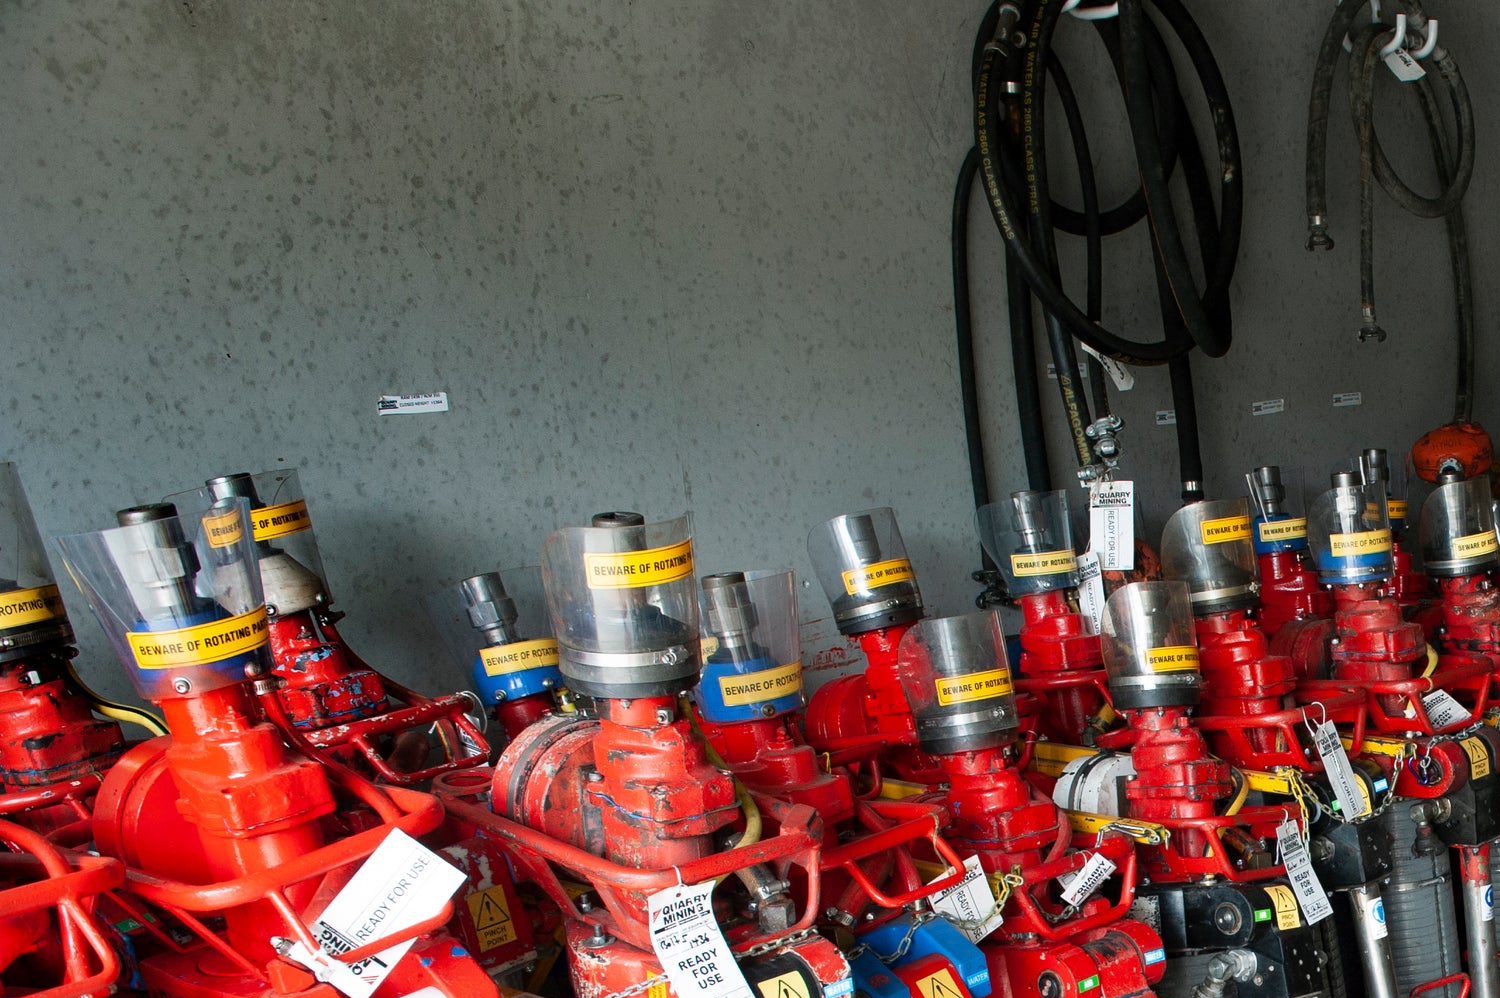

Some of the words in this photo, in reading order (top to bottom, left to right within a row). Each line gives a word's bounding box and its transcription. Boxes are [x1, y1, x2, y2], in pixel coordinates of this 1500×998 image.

[1032, 22, 1040, 39] AIR
[1024, 51, 1035, 87] WATER
[978, 74, 989, 108] WATER
[1024, 91, 1031, 105] AS
[978, 111, 986, 127] AS
[1024, 134, 1034, 172] CLASS
[982, 157, 998, 197] CLASS
[994, 199, 1001, 208] B
[1027, 185, 1039, 215] FRAS
[998, 210, 1015, 241] FRAS
[1063, 387, 1092, 466] ALFAGOMMA
[259, 517, 270, 529] OF
[1206, 525, 1232, 535] BEWARE
[1232, 524, 1239, 533] OF
[1333, 539, 1358, 549] BEWARE
[1360, 538, 1368, 547] OF
[1458, 541, 1480, 552] BEWARE
[594, 565, 636, 576] BEWARE
[639, 563, 652, 574] OF
[654, 556, 687, 571] ROTATING
[1016, 559, 1040, 569] BEWARE
[1041, 559, 1048, 567] OF
[876, 570, 883, 578] OF
[1087, 582, 1095, 605] READY
[139, 642, 184, 656] BEWARE
[187, 639, 201, 652] OF
[205, 627, 251, 648] ROTATING
[486, 653, 519, 667] BEWARE
[520, 650, 531, 661] OF
[1149, 655, 1176, 664] BEWARE
[1177, 654, 1183, 662] OF
[725, 682, 761, 697] BEWARE
[762, 680, 774, 692] OF
[942, 683, 973, 695] BEWARE
[974, 681, 983, 691] OF
[1281, 834, 1299, 844] QUARRY
[1077, 859, 1109, 895] QUARRY
[1294, 871, 1310, 882] READY
[1301, 880, 1311, 889] FOR
[355, 898, 391, 940] READY
[389, 877, 412, 904] FOR
[407, 857, 430, 880] USE
[956, 891, 969, 910] READY
[1304, 888, 1315, 897] USE
[662, 893, 709, 915] QUARRY
[663, 903, 704, 925] MINING
[484, 925, 506, 938] PINCH
[487, 935, 508, 947] POINT
[678, 948, 718, 971] READY
[692, 962, 718, 979] FOR
[967, 971, 988, 985] WATER
[698, 974, 724, 990] USE
[827, 982, 851, 997] WATER
